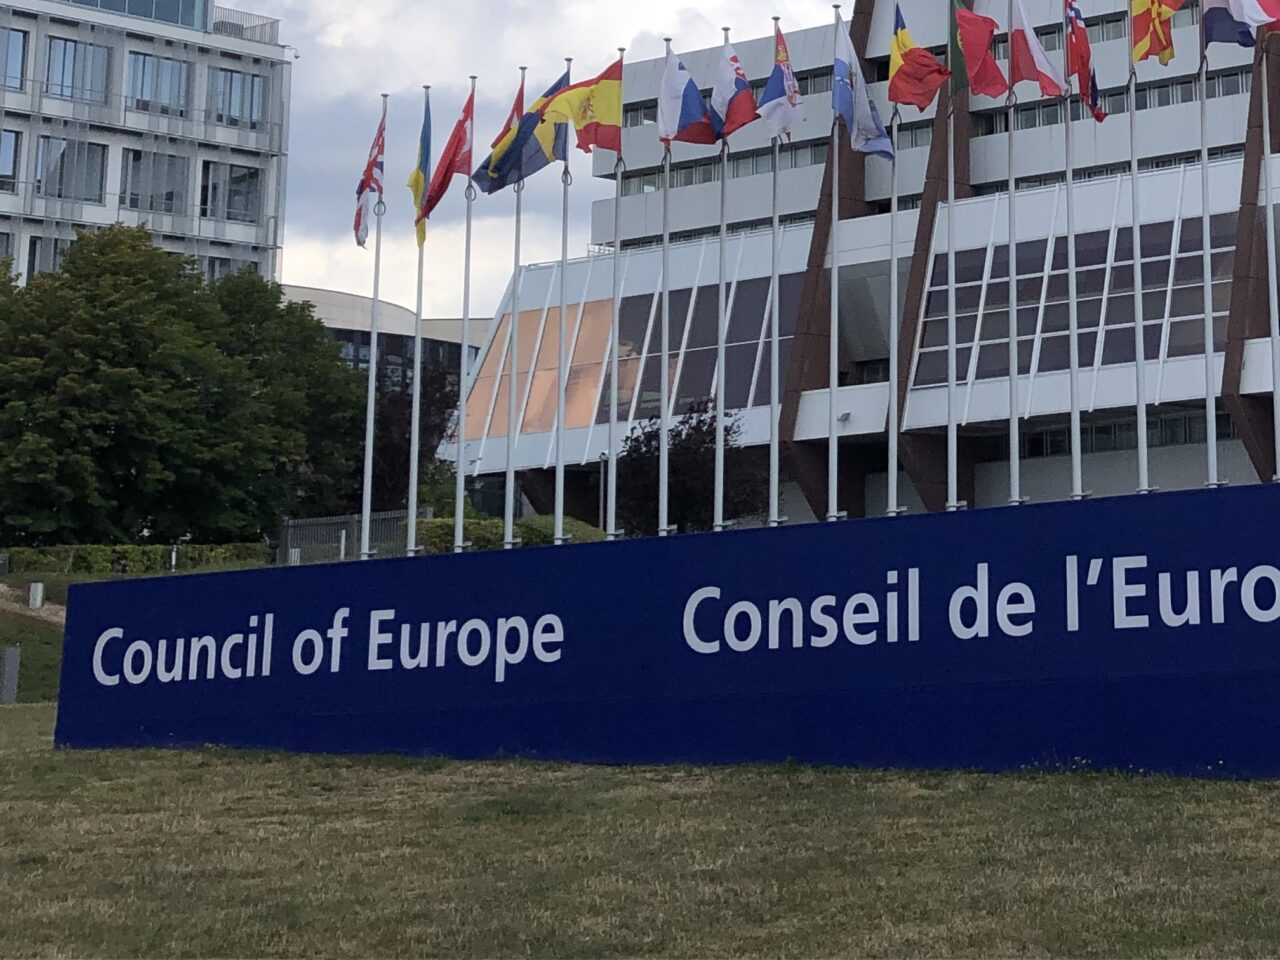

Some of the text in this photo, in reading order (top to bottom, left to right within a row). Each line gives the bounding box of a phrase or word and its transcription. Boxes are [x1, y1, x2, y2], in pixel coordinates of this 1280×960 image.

[93, 607, 564, 686] Council of Europe
[683, 567, 919, 654] Conseil
[949, 562, 1036, 640] de
